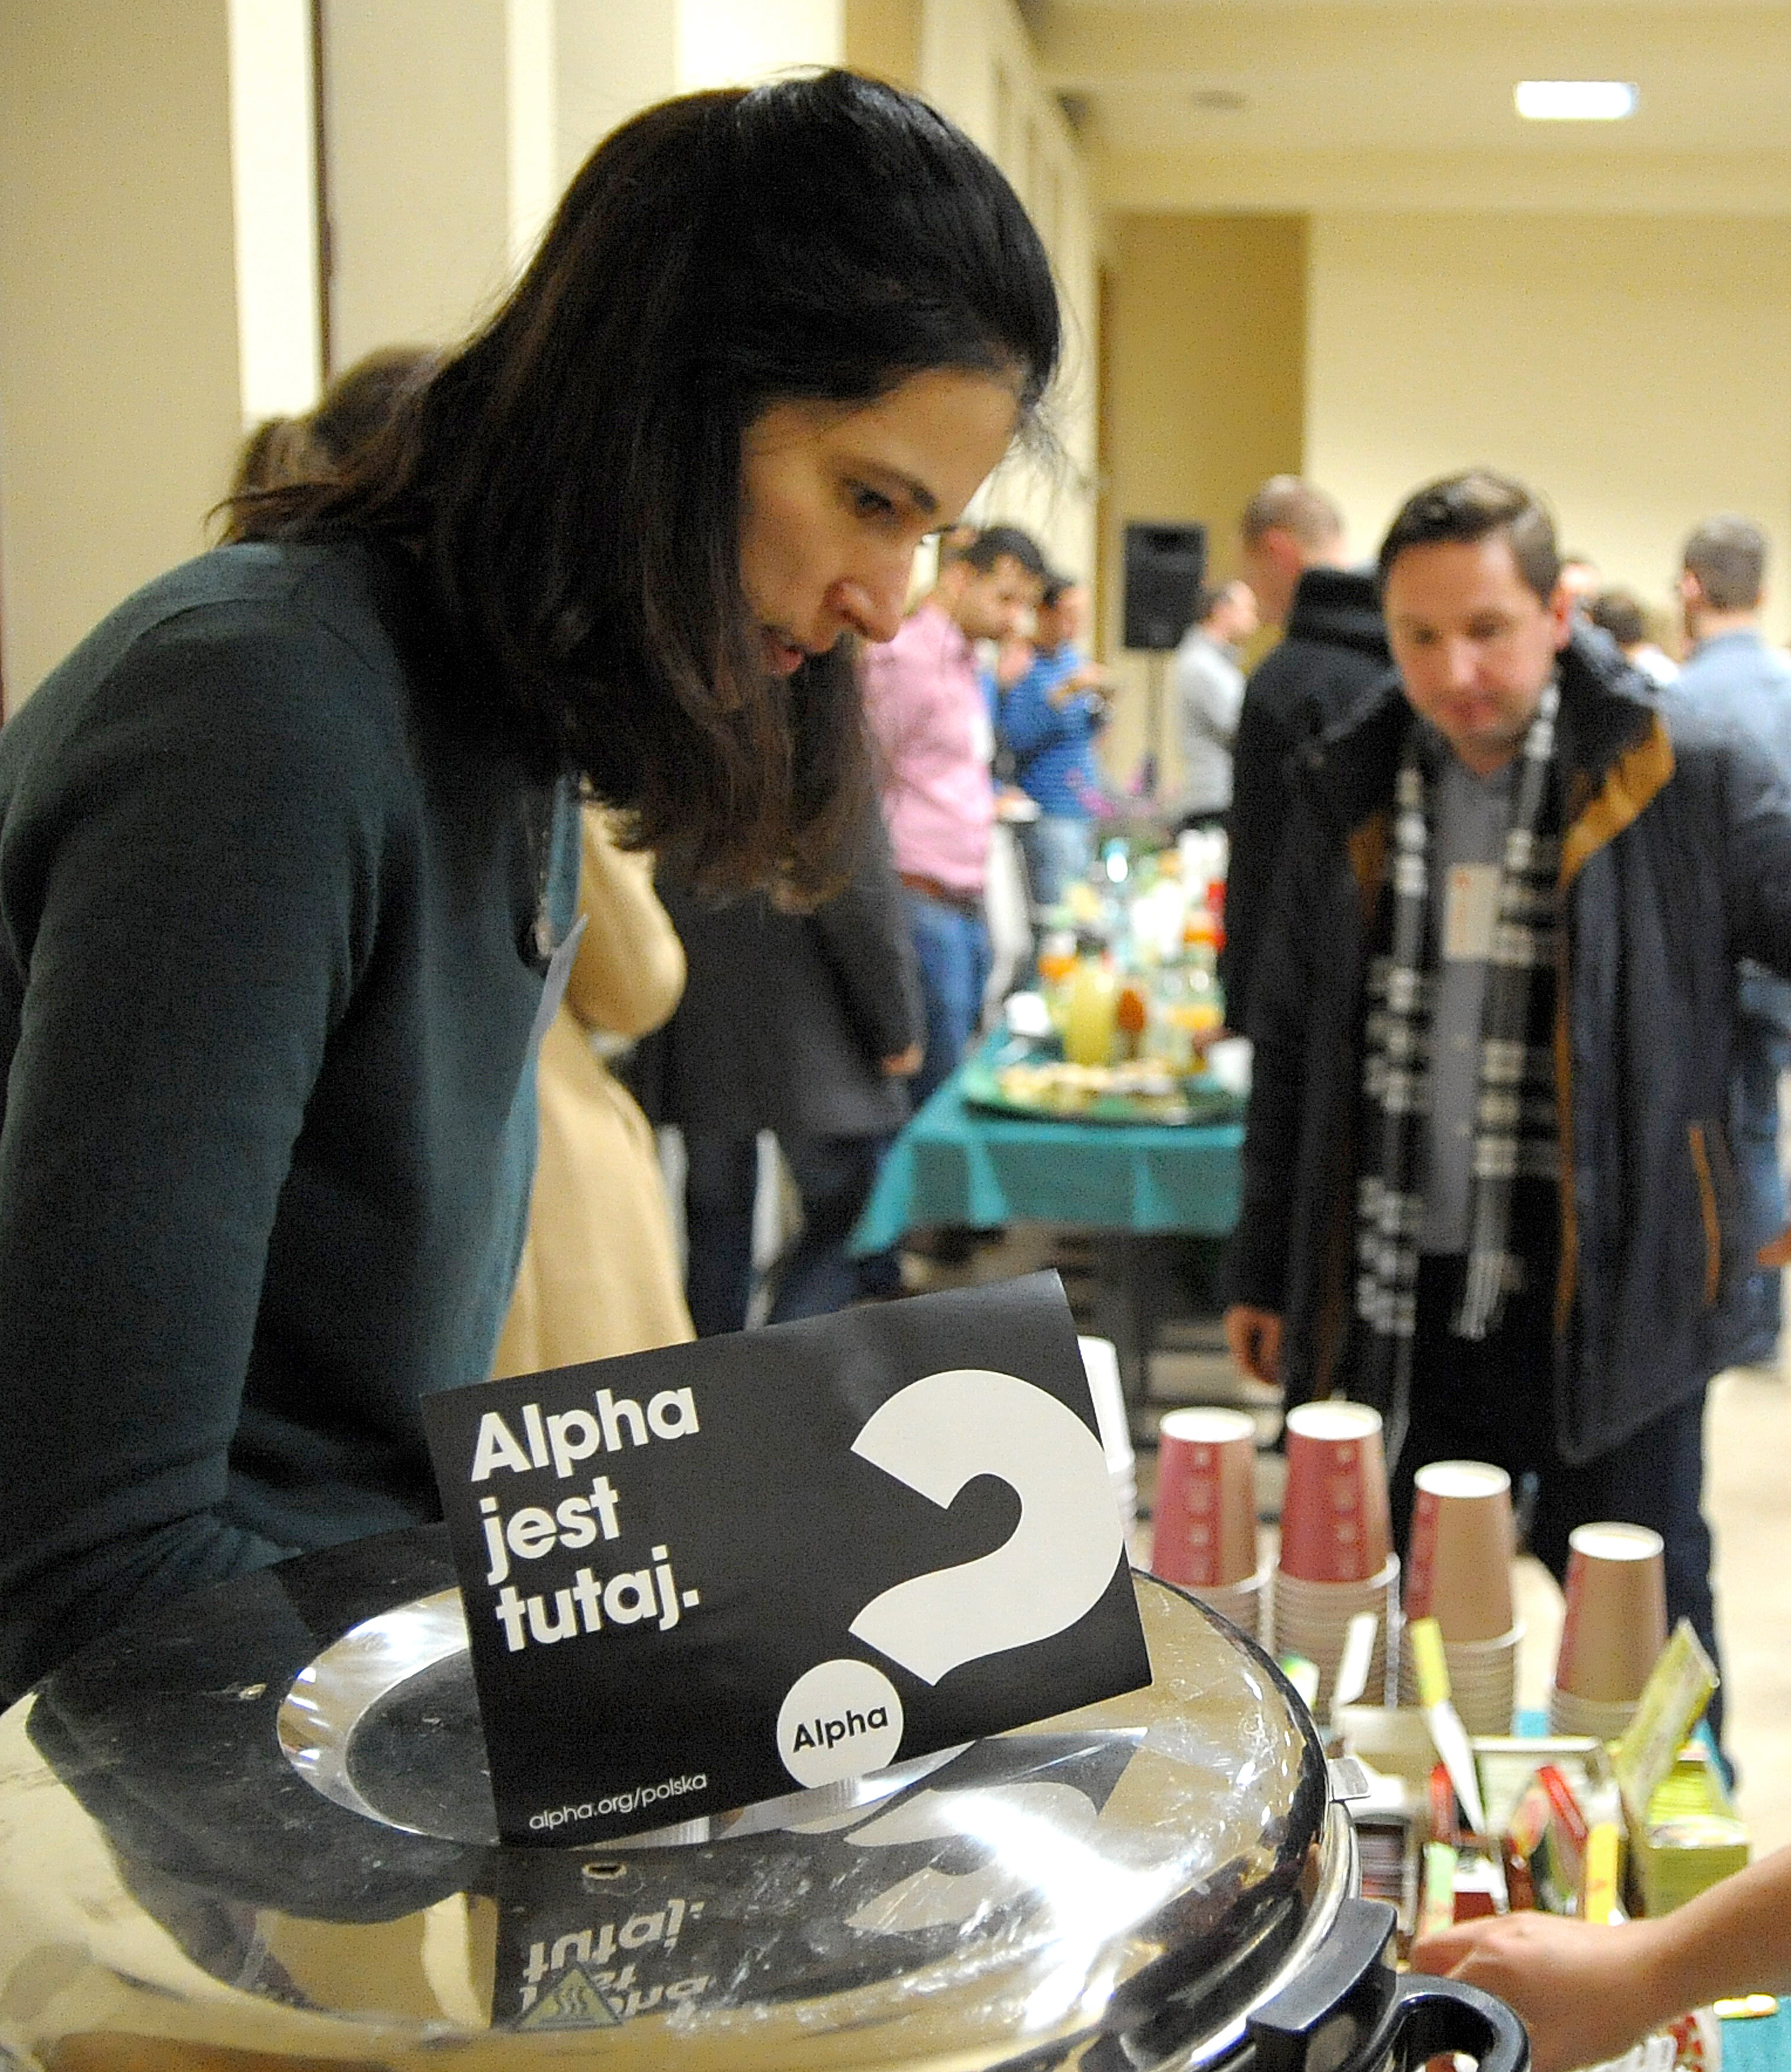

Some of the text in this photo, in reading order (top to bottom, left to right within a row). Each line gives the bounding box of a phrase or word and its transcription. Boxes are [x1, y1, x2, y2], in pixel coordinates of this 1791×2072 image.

[471, 1386, 700, 1482] Alpha
[479, 1476, 620, 1585] jest
[495, 1545, 700, 1652] tutaj.
[793, 1706, 889, 1753] Alpha
[529, 1774, 709, 1830] alpha.org/polska
